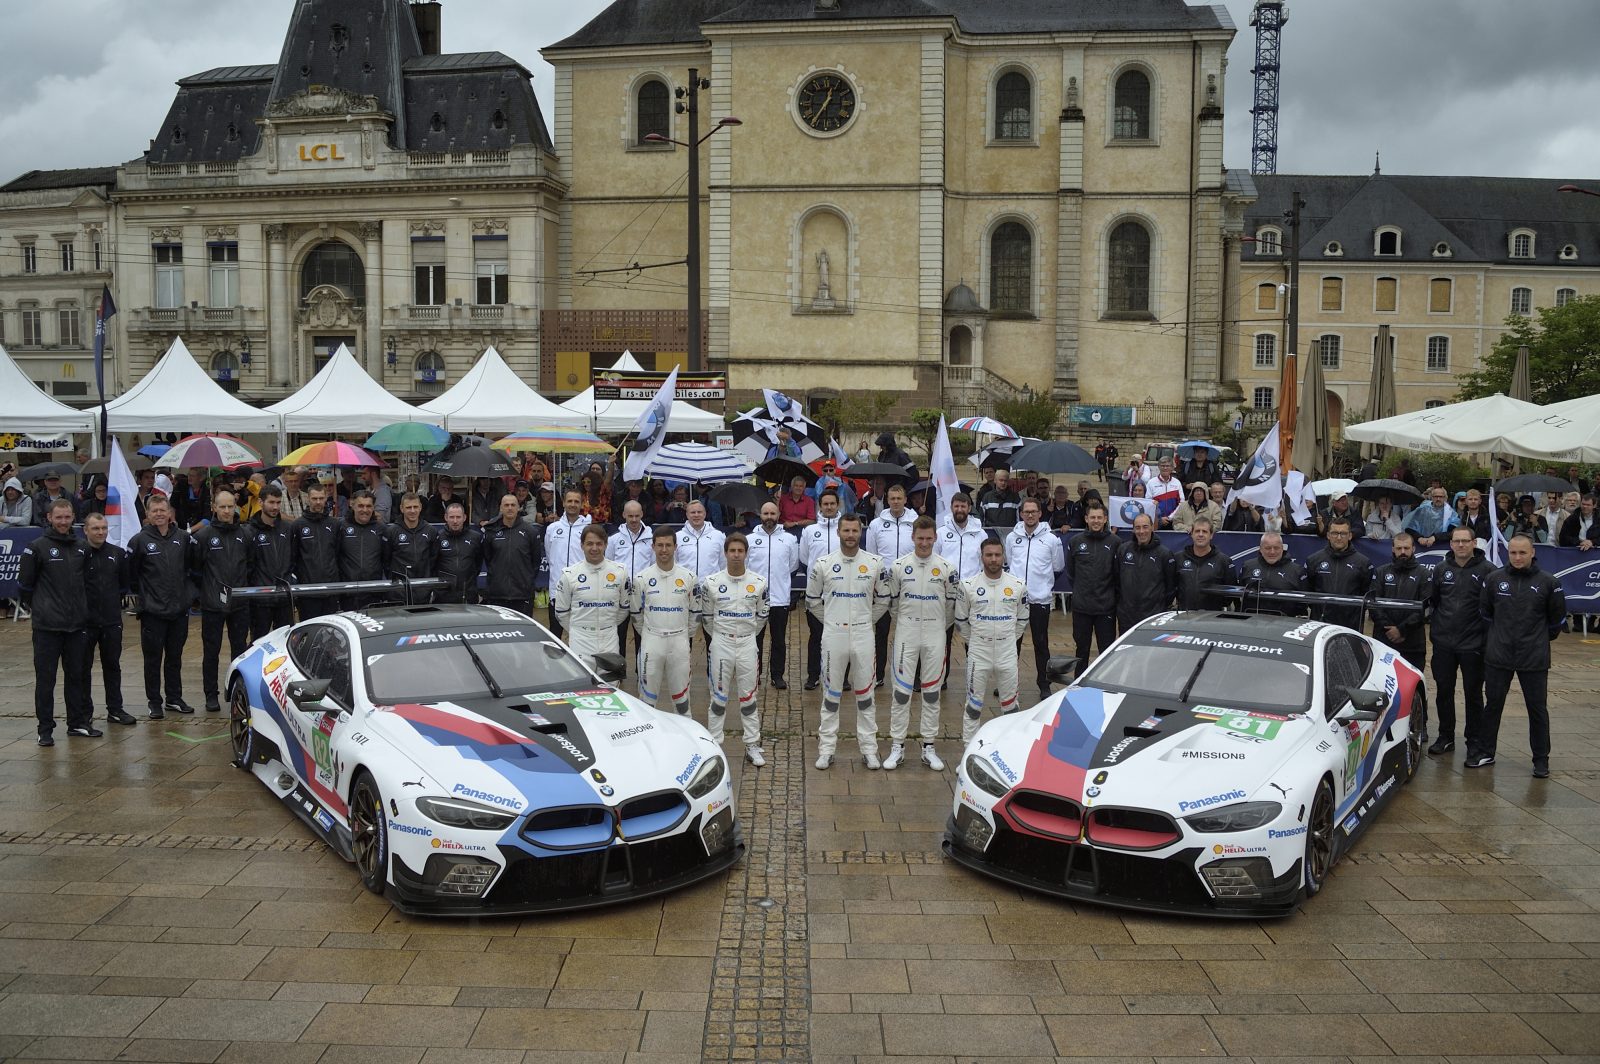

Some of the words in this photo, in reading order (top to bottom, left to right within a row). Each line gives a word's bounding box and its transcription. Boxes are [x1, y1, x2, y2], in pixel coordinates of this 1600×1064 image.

[299, 143, 344, 161] LCL
[626, 389, 720, 398] rs-autbiles.com
[831, 590, 867, 598] Panasonic
[904, 592, 939, 601] Panasonic
[649, 605, 684, 613] Panasonic
[718, 610, 753, 618] Panasonic
[976, 613, 1012, 621] Panasonic
[438, 629, 525, 643] Motorsport
[1192, 638, 1283, 655] Motorsport
[575, 695, 620, 710] 82
[269, 675, 288, 713] HELIX
[287, 708, 307, 746] ULTRA
[1196, 706, 1224, 715] PRO
[1251, 712, 1285, 721] TOTAL
[611, 723, 654, 741] #MISSION8
[1228, 716, 1272, 735] 81
[314, 735, 329, 769] 82
[1181, 751, 1246, 760] #MISSION8
[675, 753, 702, 785] Panasonic
[989, 750, 1018, 783] Panasonic
[452, 783, 522, 810] Panasonic
[1178, 789, 1247, 812] Panasonic
[388, 819, 433, 837] Panasonic
[1268, 824, 1308, 840] Panasonic
[442, 842, 464, 850] HELIX
